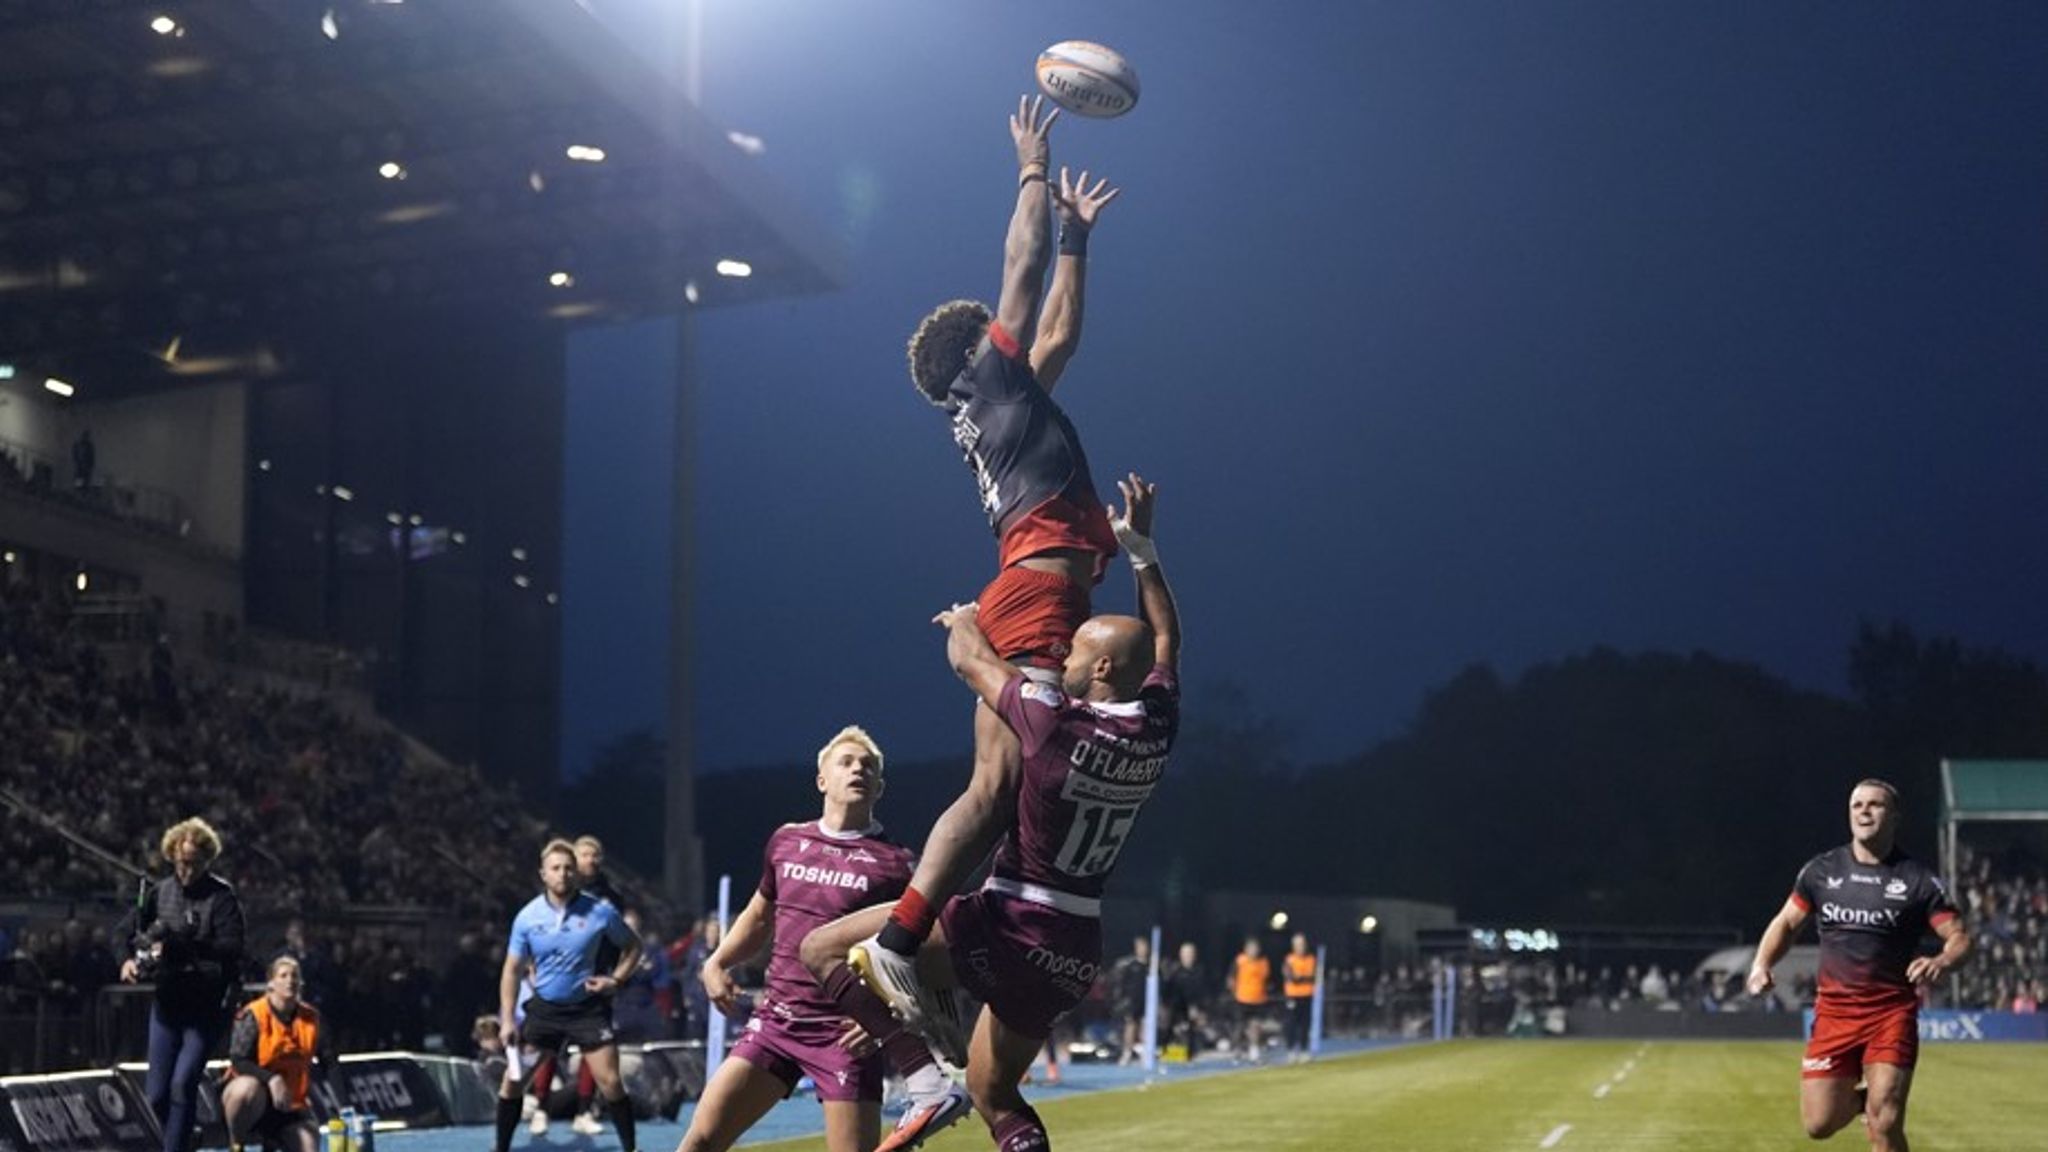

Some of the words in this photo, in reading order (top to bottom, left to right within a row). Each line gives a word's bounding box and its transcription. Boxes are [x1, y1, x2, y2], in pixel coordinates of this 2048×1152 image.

[1069, 739, 1169, 781] O'FLAHERT
[1065, 805, 1135, 875] 15
[782, 861, 869, 892] TOSHIBA
[1821, 901, 1900, 928] StoneX
